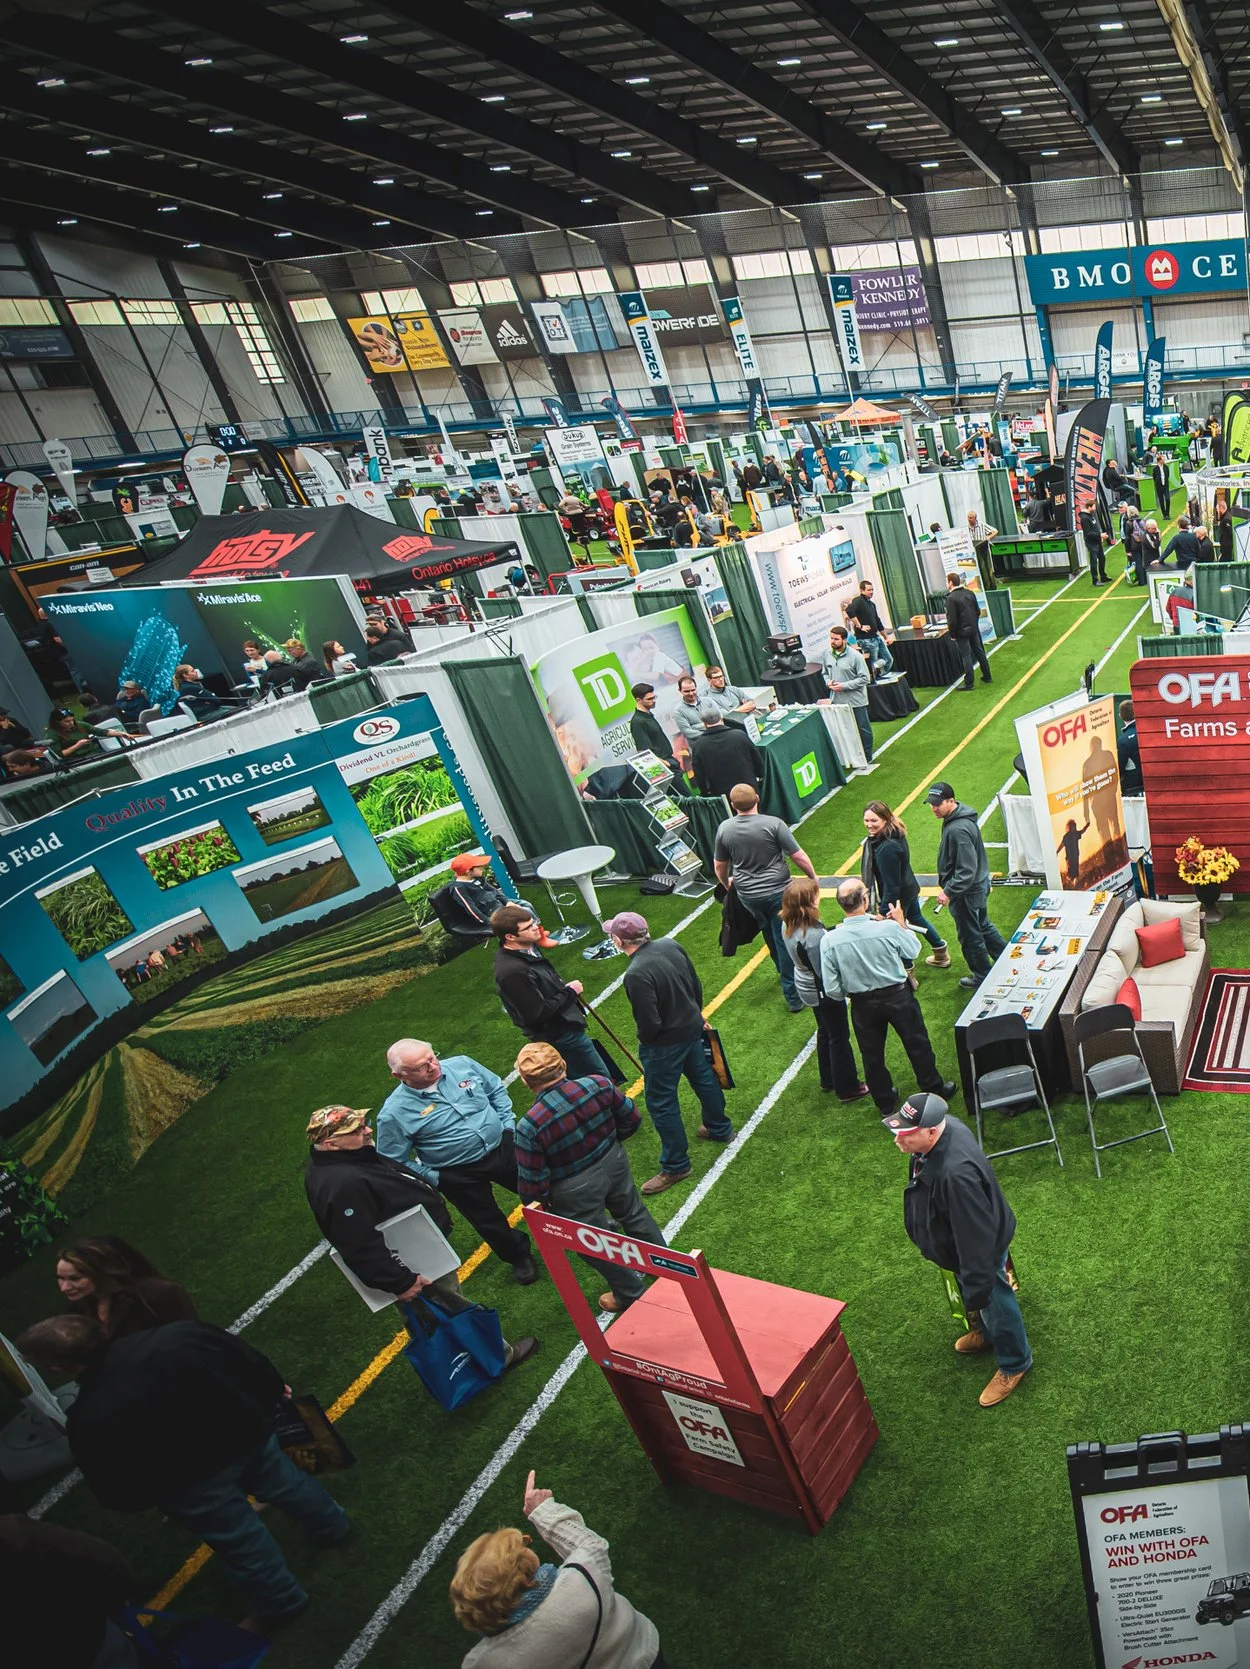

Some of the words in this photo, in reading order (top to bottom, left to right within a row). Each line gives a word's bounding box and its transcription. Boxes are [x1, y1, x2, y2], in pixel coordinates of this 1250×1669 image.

[1051, 262, 1131, 290] BMO
[861, 288, 920, 304] KENNEDY
[499, 334, 528, 347] adidas
[841, 309, 860, 364] maizex
[635, 326, 662, 380] maizex
[736, 334, 754, 369] ELITE
[1097, 344, 1111, 399] ARGIS
[996, 377, 1008, 410] TITAN
[1148, 359, 1162, 408] ARGIS
[911, 396, 931, 418] TITAN
[70, 561, 99, 571] can-am
[411, 561, 452, 581] Ontario
[61, 603, 96, 614] Miravis
[96, 602, 114, 612] Neo
[209, 594, 244, 605] Miravis
[244, 592, 262, 603] Ace
[765, 563, 788, 633] www.toewsp
[794, 595, 815, 608] ELECTRICAL
[581, 668, 628, 712] TD
[1158, 672, 1241, 708] OFA
[360, 720, 394, 738] QS
[601, 720, 633, 750] AGRICUL
[1043, 714, 1087, 748] OFA
[1164, 717, 1238, 739] Farms
[339, 755, 374, 773] Dividend
[374, 751, 386, 760] VL
[386, 736, 432, 756] Orchardgrass
[365, 764, 380, 774] One
[396, 752, 417, 763] Kind!
[793, 760, 817, 789] TD
[1056, 791, 1069, 801] Who
[1094, 772, 1108, 781] them
[9, 832, 64, 870] Field
[85, 793, 168, 832] Quality
[170, 783, 198, 802] In
[199, 767, 246, 795] The
[250, 752, 297, 778] Feed
[1111, 872, 1124, 881] Farm
[576, 1227, 646, 1266] OFA
[636, 1361, 707, 1389] #OntAgProud
[678, 1400, 713, 1416] support
[690, 1410, 704, 1420] the
[679, 1415, 729, 1441] OFA
[685, 1433, 707, 1445] Farm
[709, 1439, 736, 1454] Safety
[693, 1442, 737, 1460] Campaign
[1100, 1503, 1149, 1525] OFA
[1104, 1533, 1127, 1544] OFA
[1129, 1526, 1187, 1541] MEMBERS:
[1106, 1544, 1135, 1558] WIN
[1139, 1539, 1175, 1553] WITH
[1179, 1535, 1210, 1548] OFA
[1107, 1556, 1140, 1569] AND
[1143, 1549, 1198, 1565] HONDA
[1125, 1575, 1142, 1583] your
[1159, 1567, 1197, 1579] membership
[1198, 1565, 1212, 1573] card
[1156, 1577, 1172, 1585] three
[1173, 1575, 1190, 1584] great
[1191, 1573, 1211, 1583] prizes:
[1135, 1589, 1159, 1597] Pioneer
[1138, 1594, 1164, 1603] DELUXE
[1118, 1603, 1157, 1612] Side-by-Side
[1120, 1613, 1154, 1622] Ultra-Quiet
[1121, 1620, 1144, 1628] Electric
[1145, 1618, 1160, 1626] Start
[1161, 1614, 1191, 1624] Generator
[1123, 1635, 1158, 1645] Powerhead
[1159, 1632, 1172, 1640] with
[1124, 1643, 1140, 1651] Brush
[1141, 1640, 1162, 1649] Cutter
[1163, 1635, 1199, 1646] Attachment
[1142, 1650, 1218, 1669] HONDA
